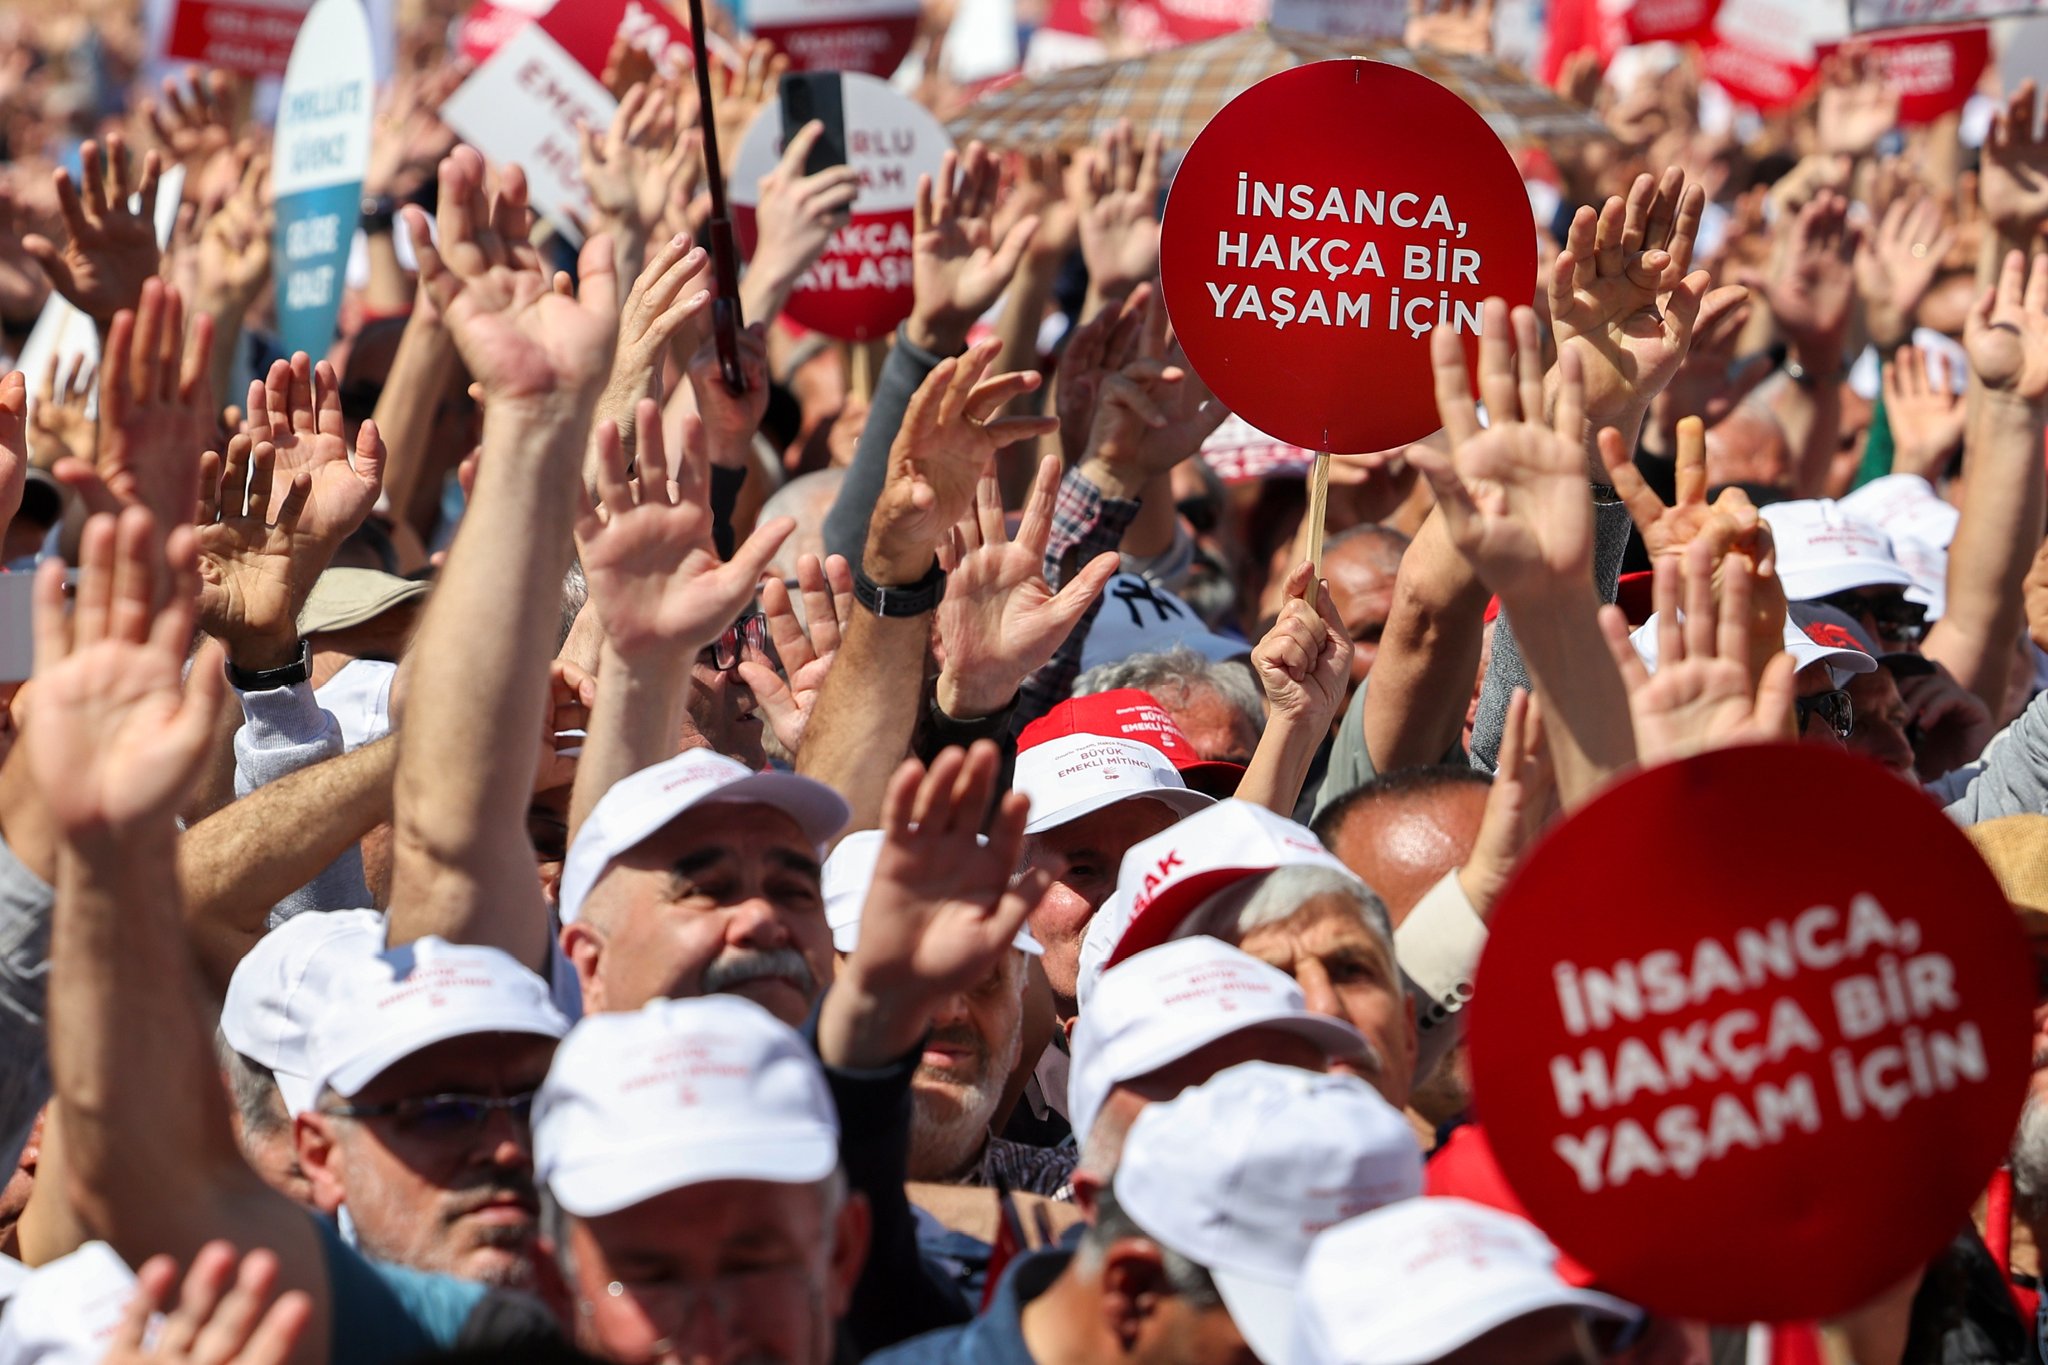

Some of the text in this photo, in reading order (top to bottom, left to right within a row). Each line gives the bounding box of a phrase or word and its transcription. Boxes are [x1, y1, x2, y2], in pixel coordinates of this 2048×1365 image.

[1236, 171, 1468, 239] İNSANCA,
[824, 221, 913, 255] AKÇA
[1217, 230, 1481, 284] HAKÇA BİR
[1205, 281, 1485, 339] YAŞAM İÇİN
[1080, 747, 1124, 760] BÜYÜK
[1121, 722, 1162, 733] EMEKLİ
[1057, 756, 1152, 778] EMEKLİ MİTİNGİ
[1552, 891, 1922, 1037] İNSANCA,
[1549, 952, 1960, 1118] HAKÇA BİR
[1552, 1020, 1990, 1193] YAŞAM İÇİN
